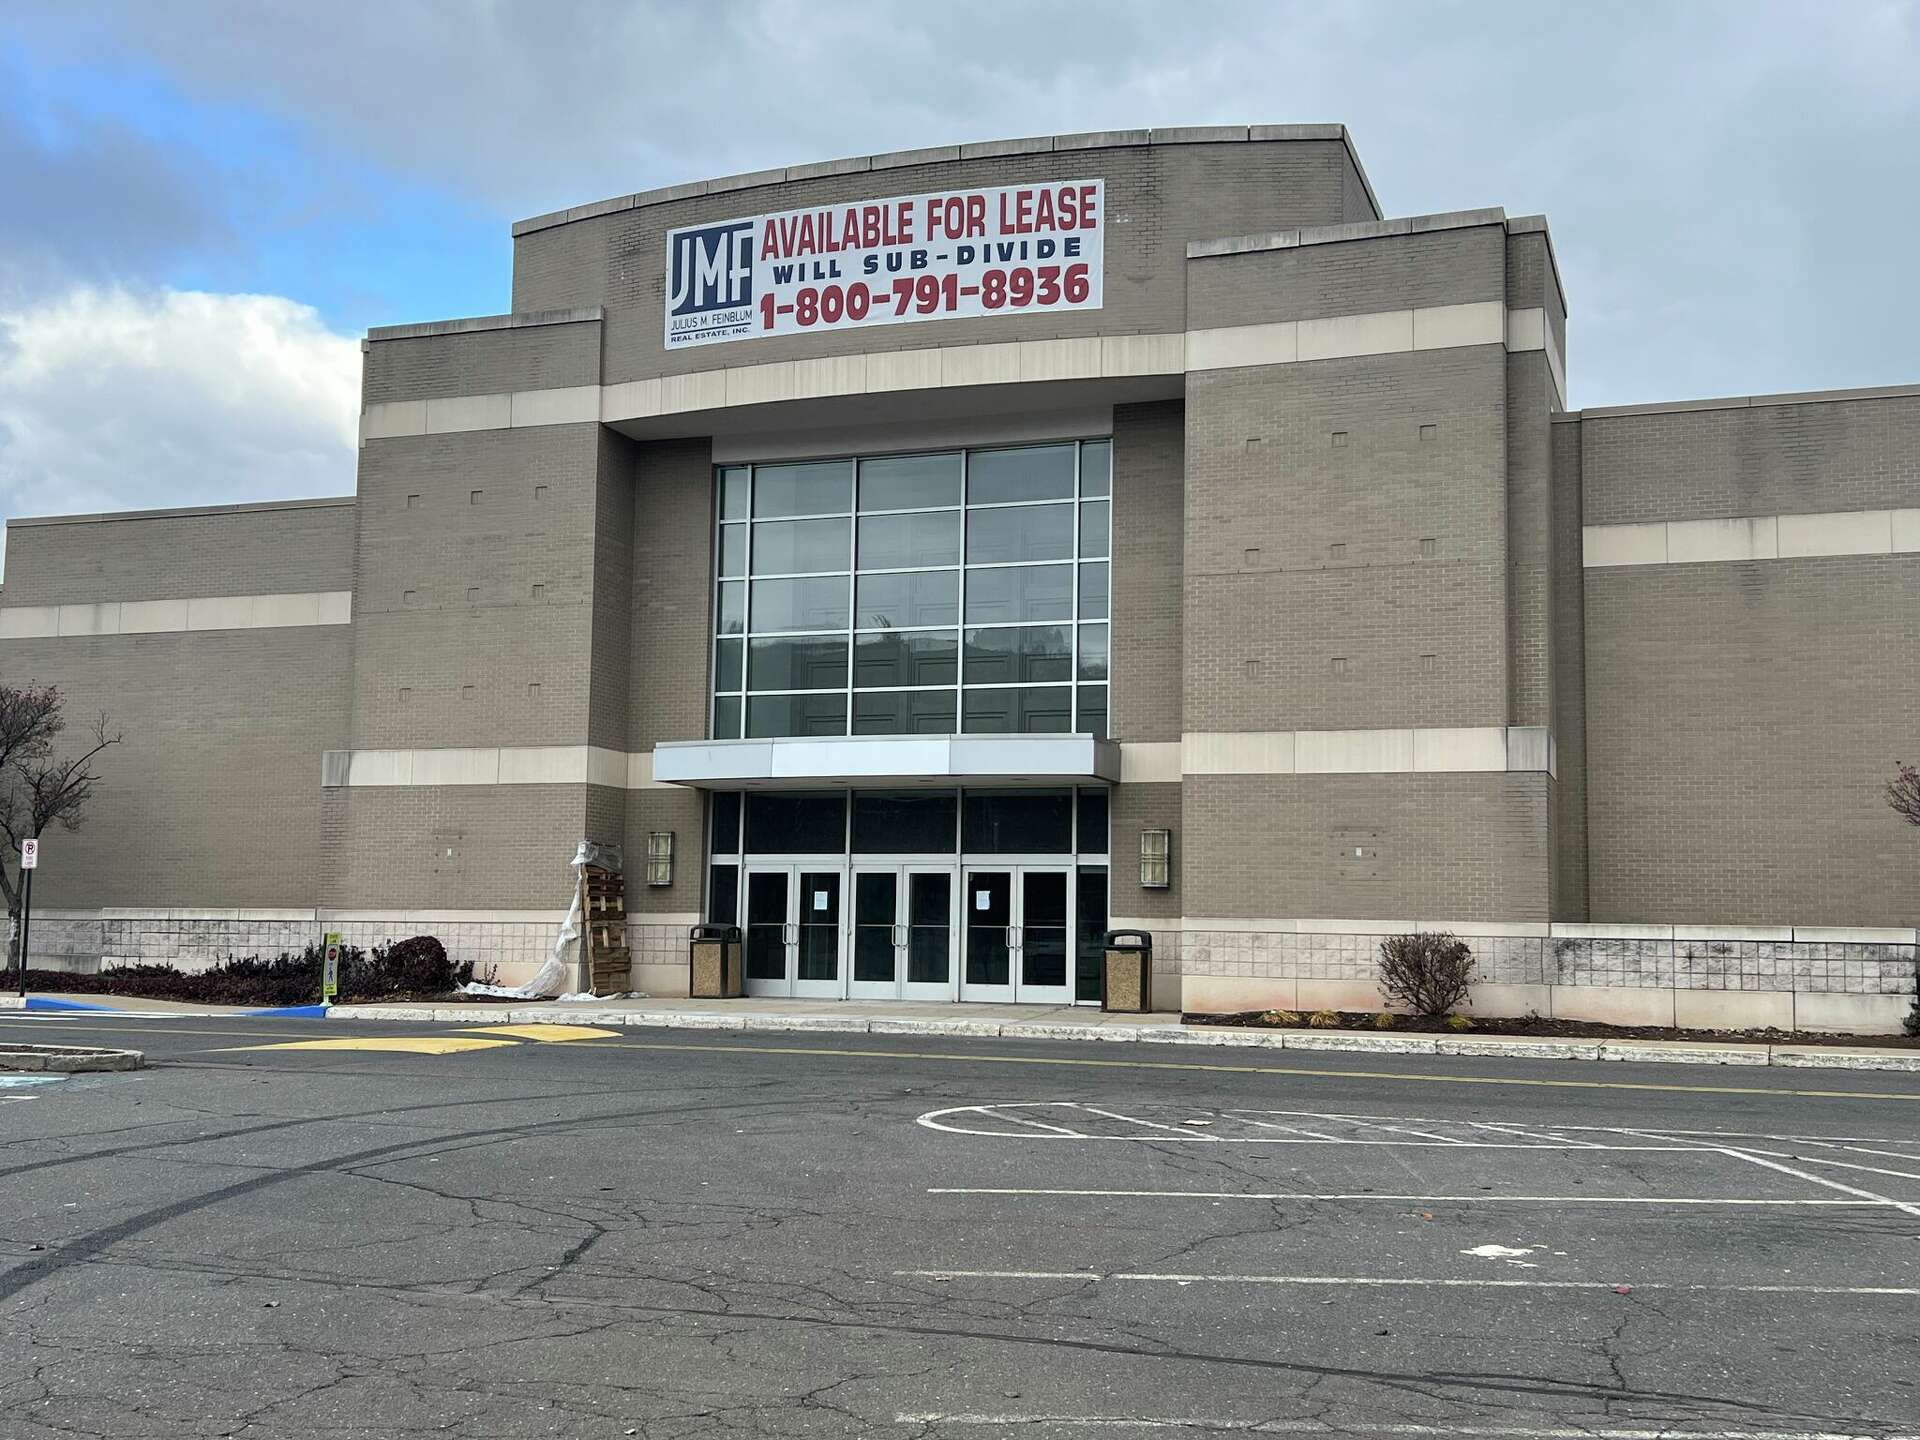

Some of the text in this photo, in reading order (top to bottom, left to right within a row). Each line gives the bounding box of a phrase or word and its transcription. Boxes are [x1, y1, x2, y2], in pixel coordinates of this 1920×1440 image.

[760, 185, 1097, 261] AVAILABLE FOR LEASE
[672, 228, 753, 311] JMF
[773, 237, 1081, 285] WILL SUB-DIVIDE
[671, 317, 698, 331] JULIUS
[712, 310, 752, 325] FEINBLUM
[760, 263, 1090, 330] 1-800-791-8936
[671, 335, 693, 343] REAL
